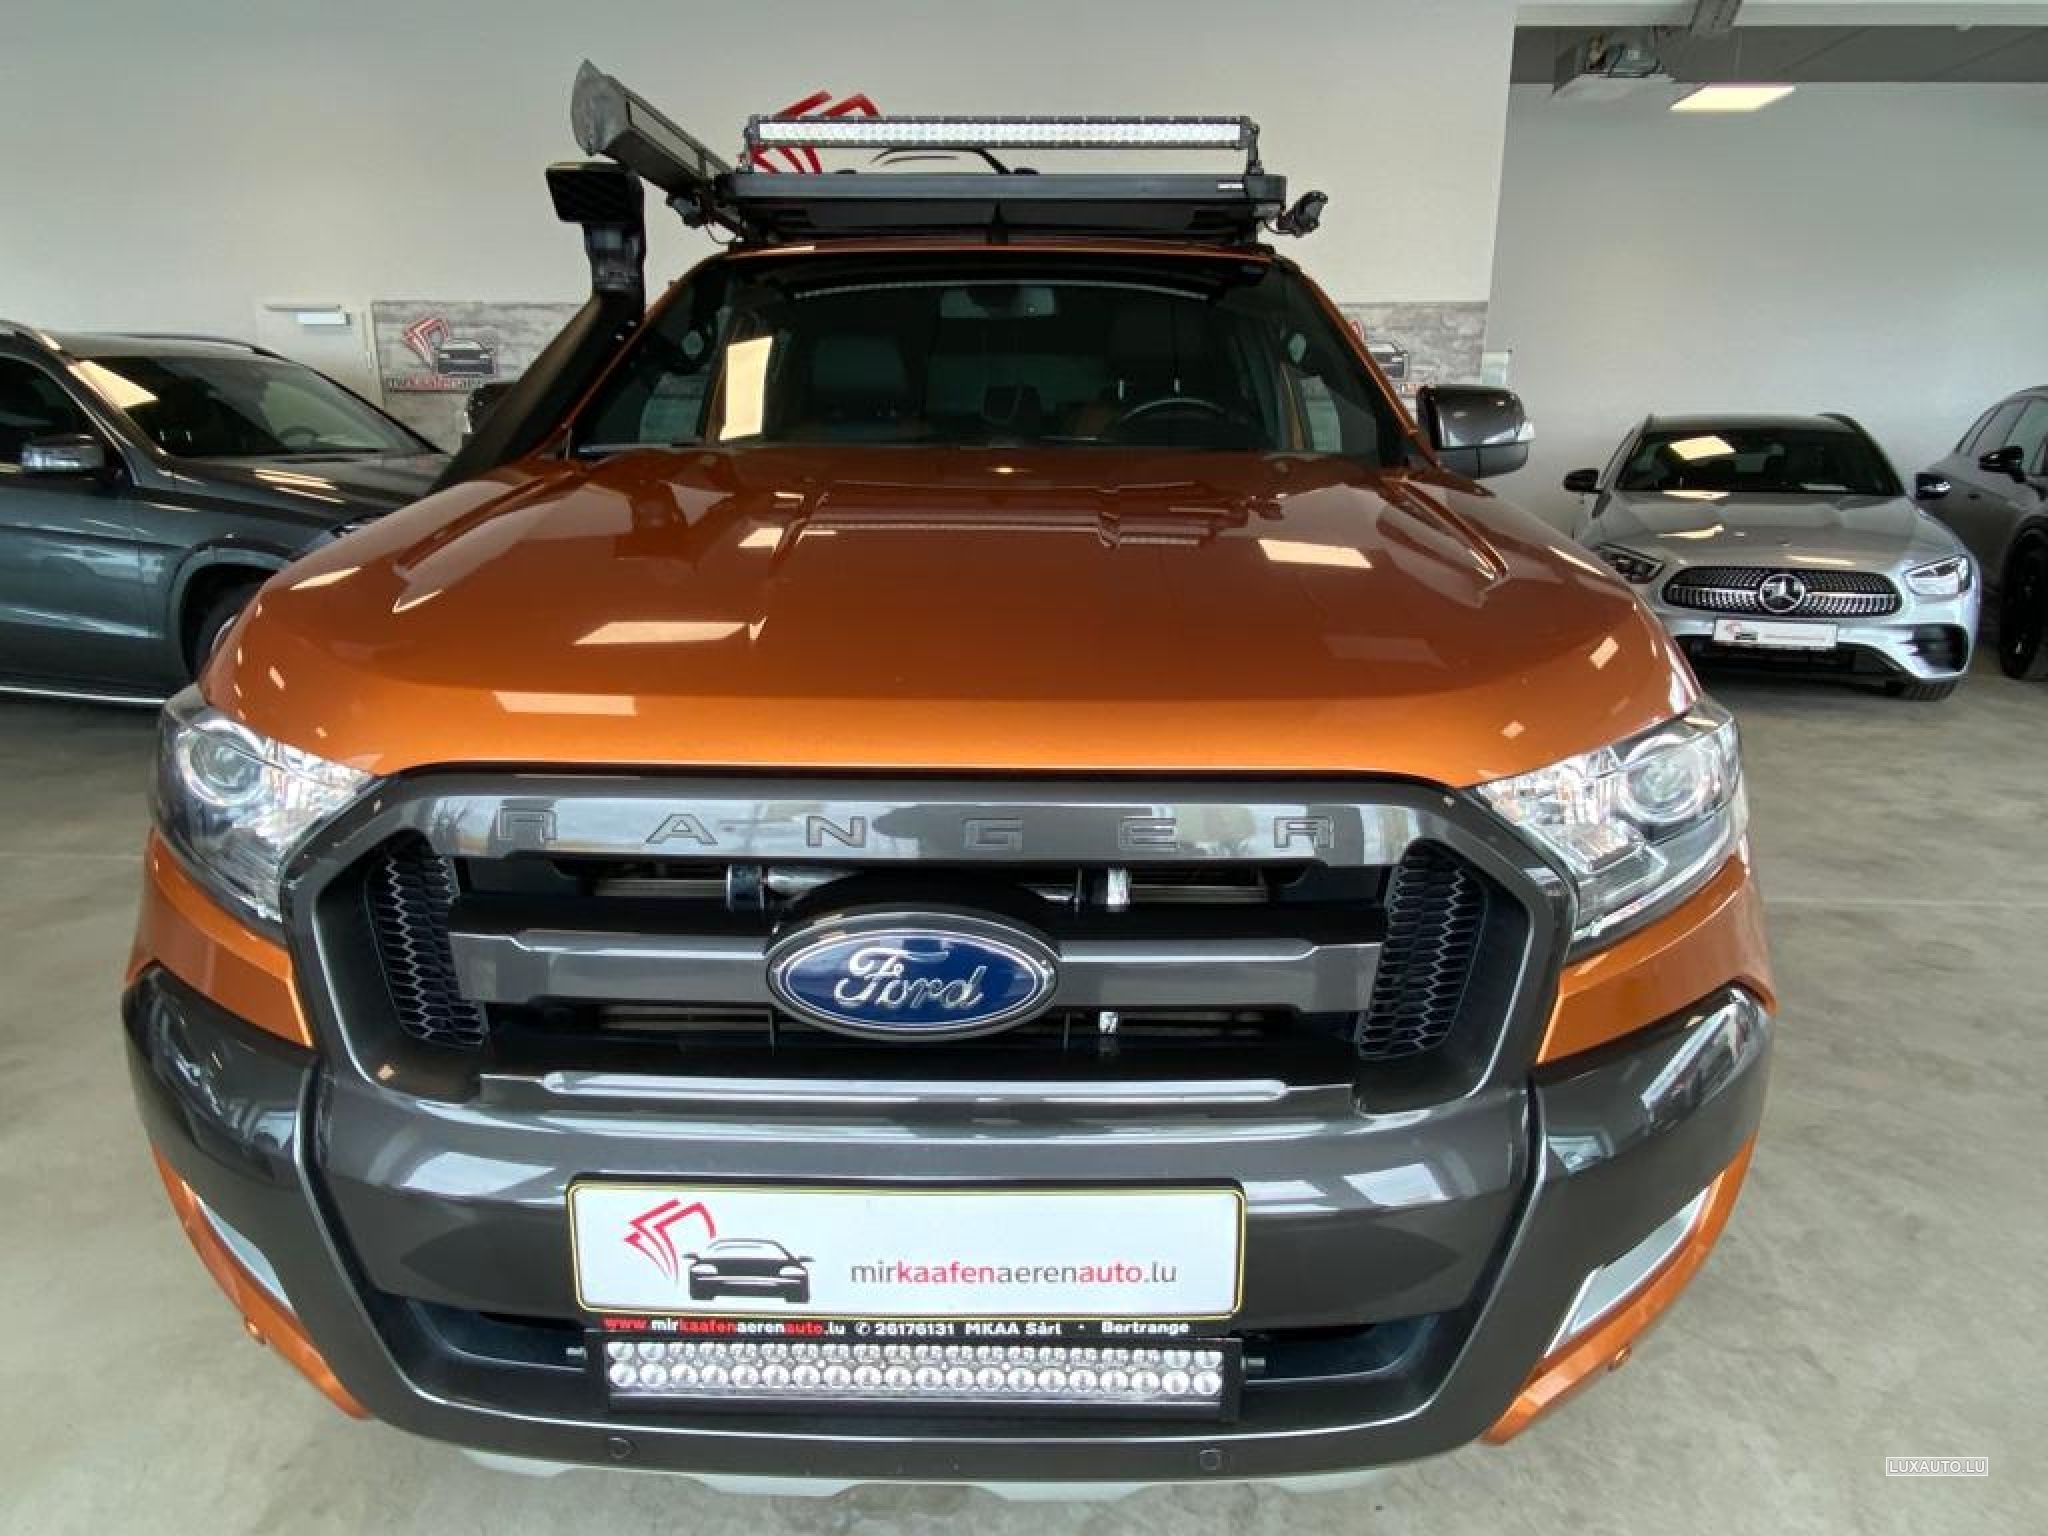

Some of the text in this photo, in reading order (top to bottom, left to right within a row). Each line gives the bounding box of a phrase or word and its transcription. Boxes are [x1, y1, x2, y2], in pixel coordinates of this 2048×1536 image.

[496, 807, 1335, 851] RANGER
[833, 947, 988, 1009] Ford
[850, 1260, 1178, 1284] mirkaafenaerenauto.lu
[965, 1322, 1021, 1335] MKAA
[1101, 1321, 1189, 1337] Bertrange
